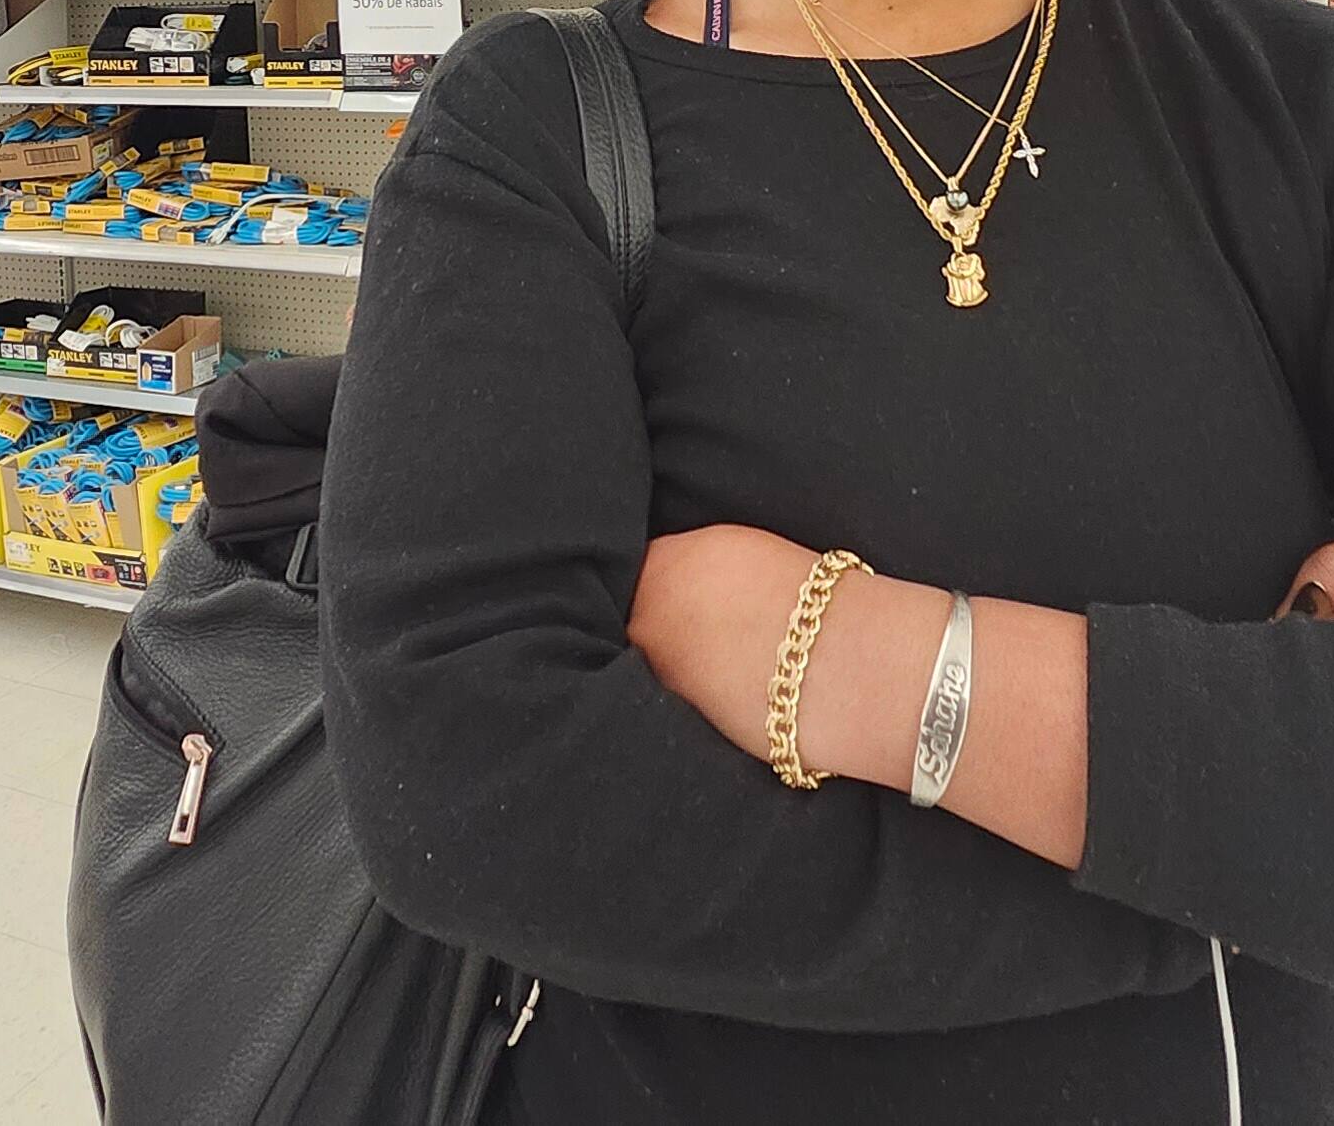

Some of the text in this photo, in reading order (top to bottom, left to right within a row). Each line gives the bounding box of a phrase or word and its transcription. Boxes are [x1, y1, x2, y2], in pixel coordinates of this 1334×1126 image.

[712, 3, 722, 41] CALVIN
[54, 51, 82, 60] STANLEY
[89, 59, 139, 72] STANLEY
[267, 61, 305, 71] STANLEY
[47, 349, 93, 364] STANLEY
